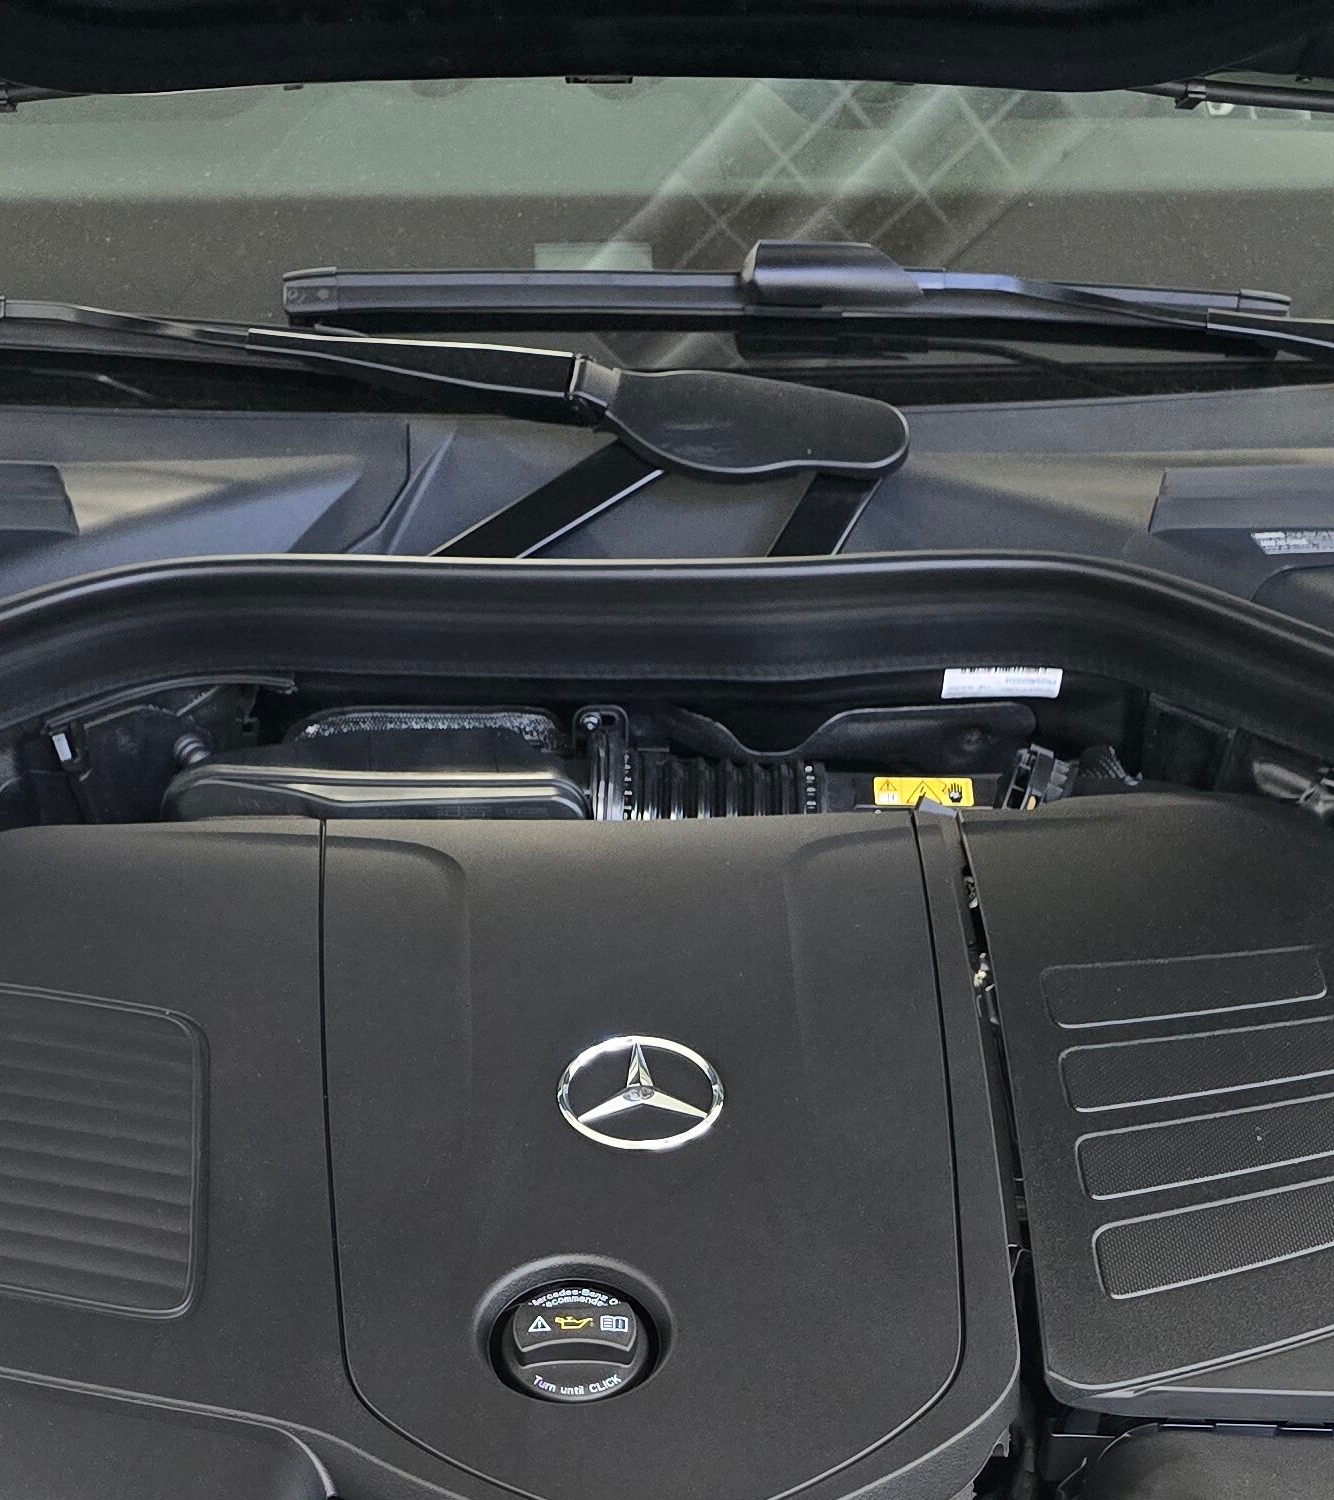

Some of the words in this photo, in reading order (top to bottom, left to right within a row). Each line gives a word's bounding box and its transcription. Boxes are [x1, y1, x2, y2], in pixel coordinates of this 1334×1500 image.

[533, 1374, 556, 1393] Turn
[560, 1384, 585, 1395] until
[589, 1374, 622, 1393] CLICK
